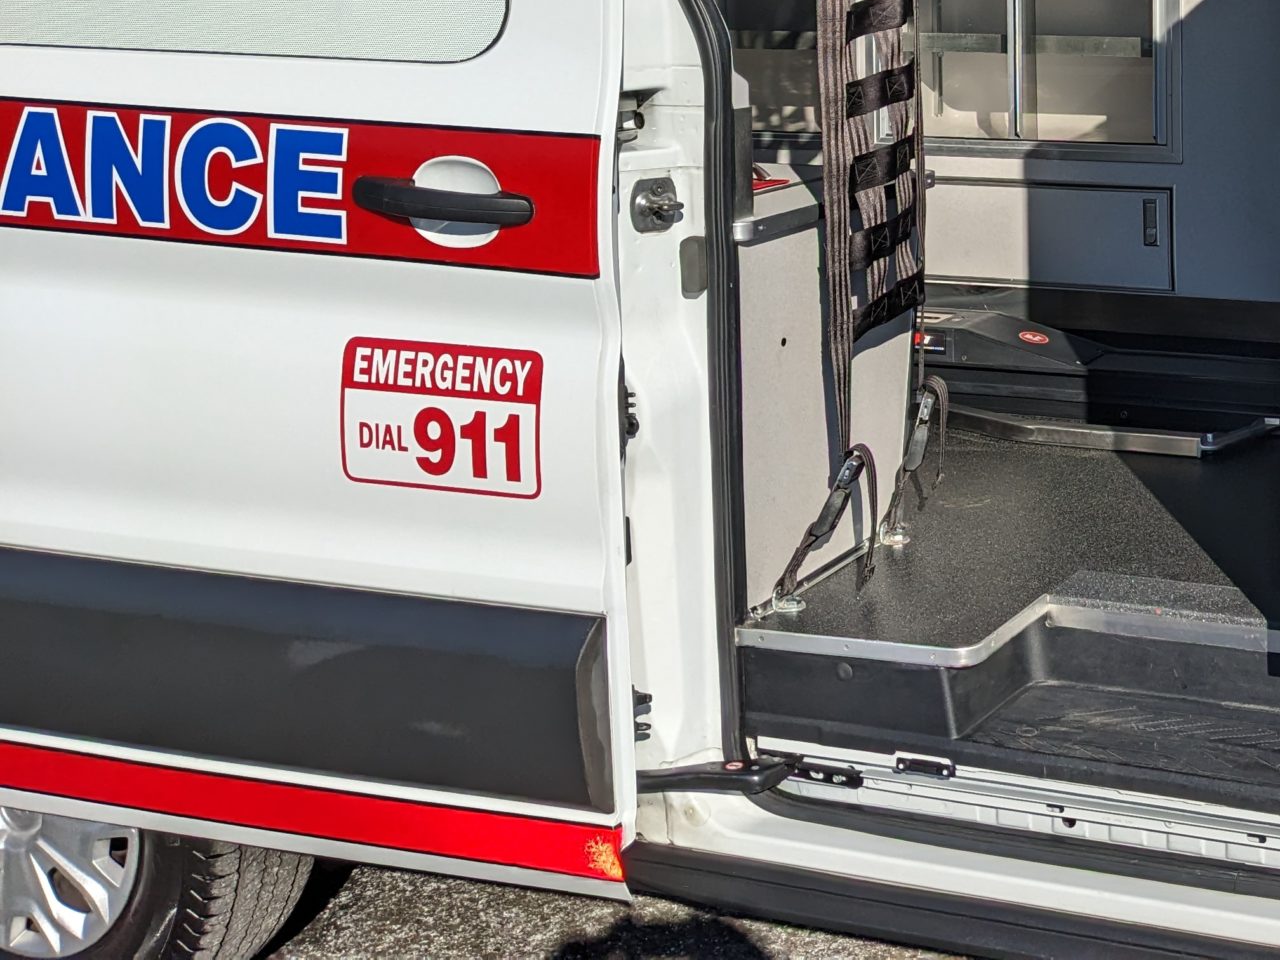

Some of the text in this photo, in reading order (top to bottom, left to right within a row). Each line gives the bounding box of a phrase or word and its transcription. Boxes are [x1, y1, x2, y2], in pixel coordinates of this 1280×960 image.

[0, 106, 349, 245] ANCE
[353, 346, 532, 396] EMERGENCY
[359, 406, 522, 483] DIAL 911
